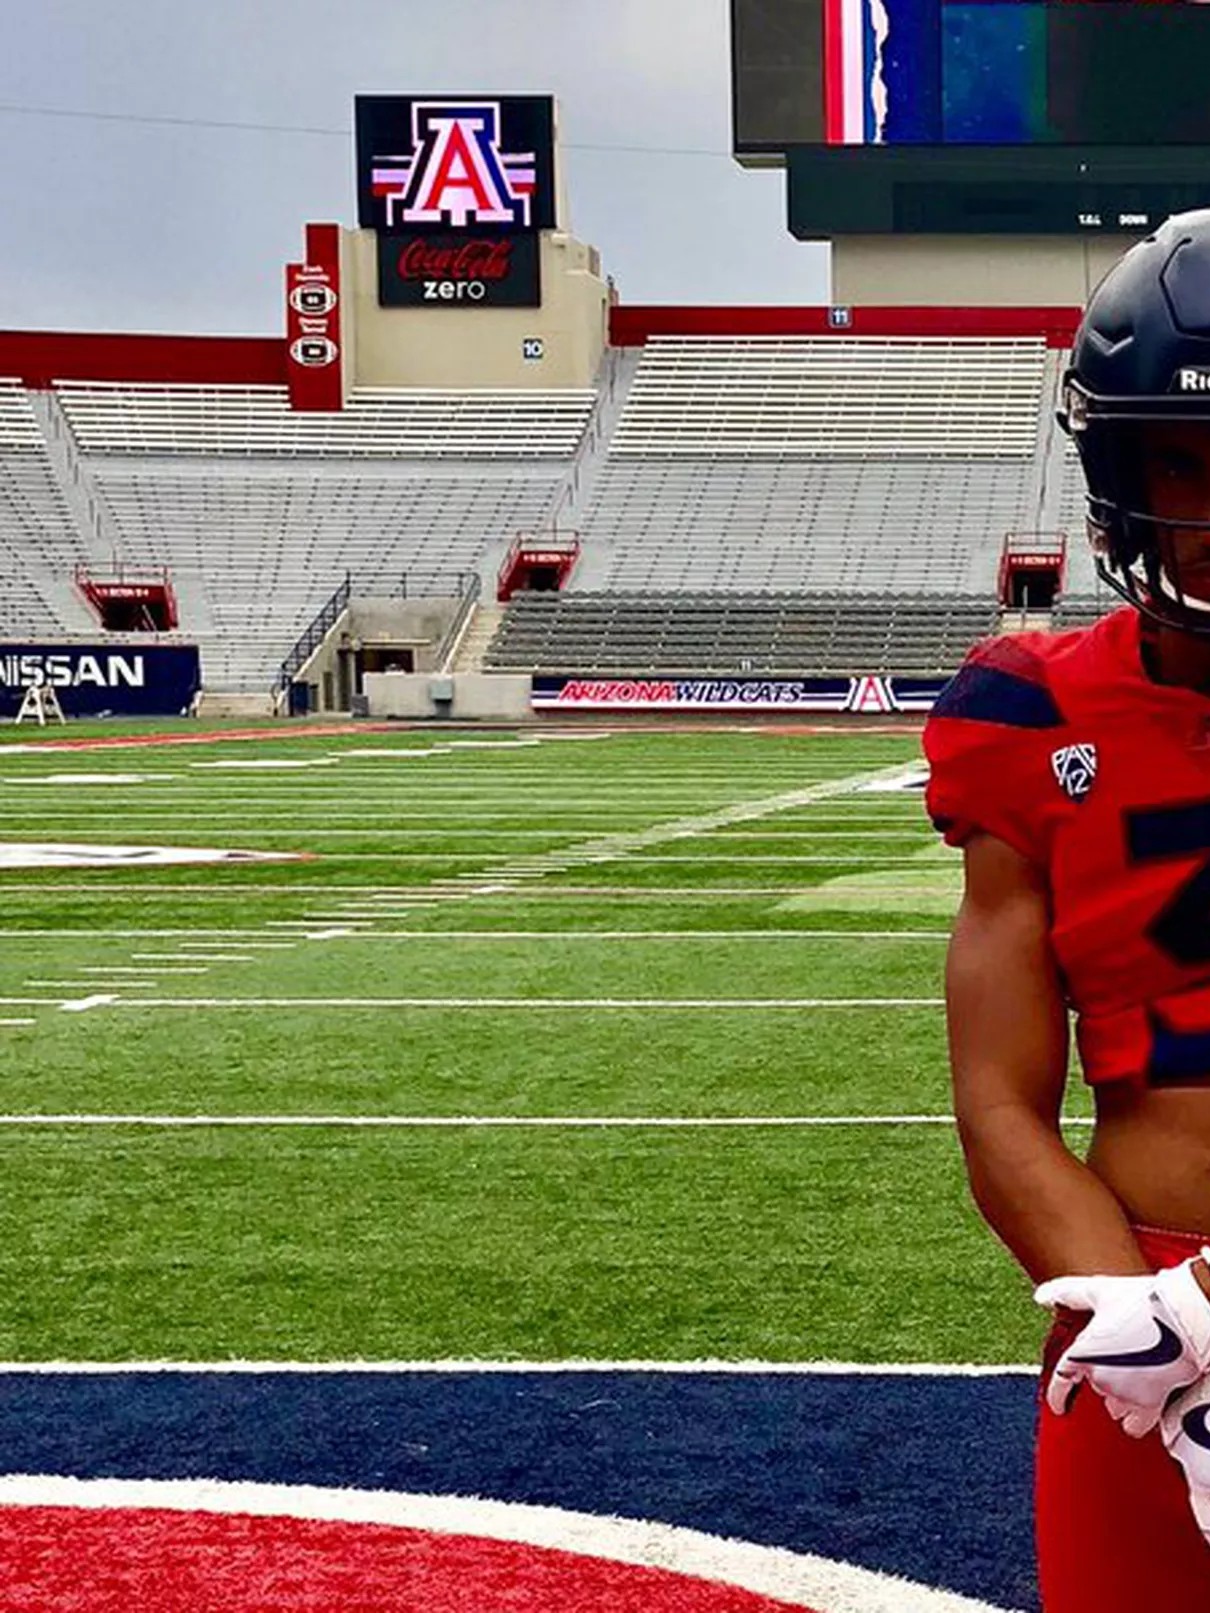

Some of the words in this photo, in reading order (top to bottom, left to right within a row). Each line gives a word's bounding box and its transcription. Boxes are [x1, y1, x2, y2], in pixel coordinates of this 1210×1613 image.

[423, 280, 486, 300] zero
[524, 341, 543, 356] 10
[1051, 743, 1097, 785] PAC
[1066, 768, 1091, 796] 12
